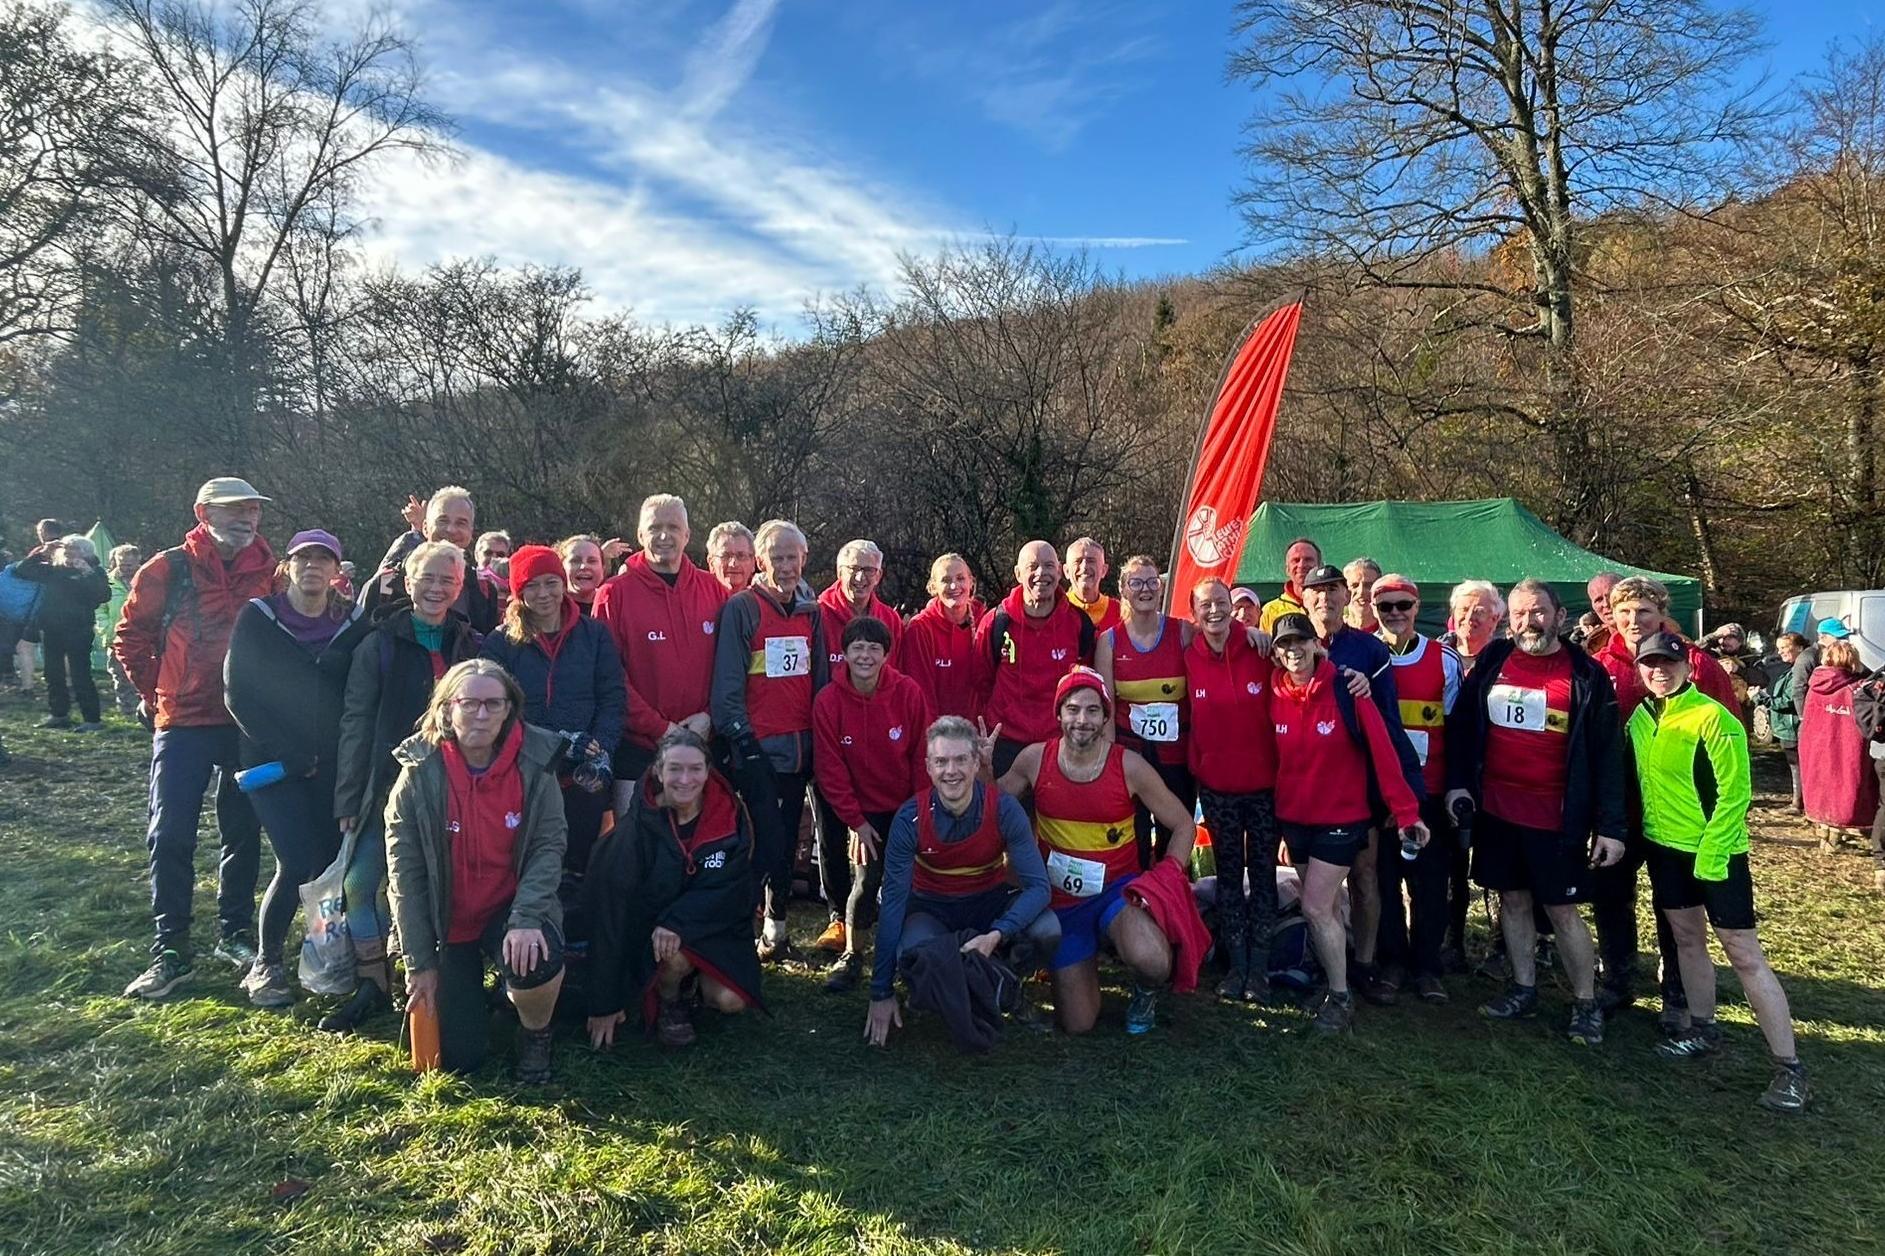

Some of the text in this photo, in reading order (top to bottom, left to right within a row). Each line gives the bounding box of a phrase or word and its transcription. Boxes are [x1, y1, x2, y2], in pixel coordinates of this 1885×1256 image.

[647, 631, 667, 641] G.L
[783, 654, 799, 671] 37
[1506, 705, 1525, 724] 18
[1140, 719, 1167, 736] 750
[1063, 874, 1083, 893] 69
